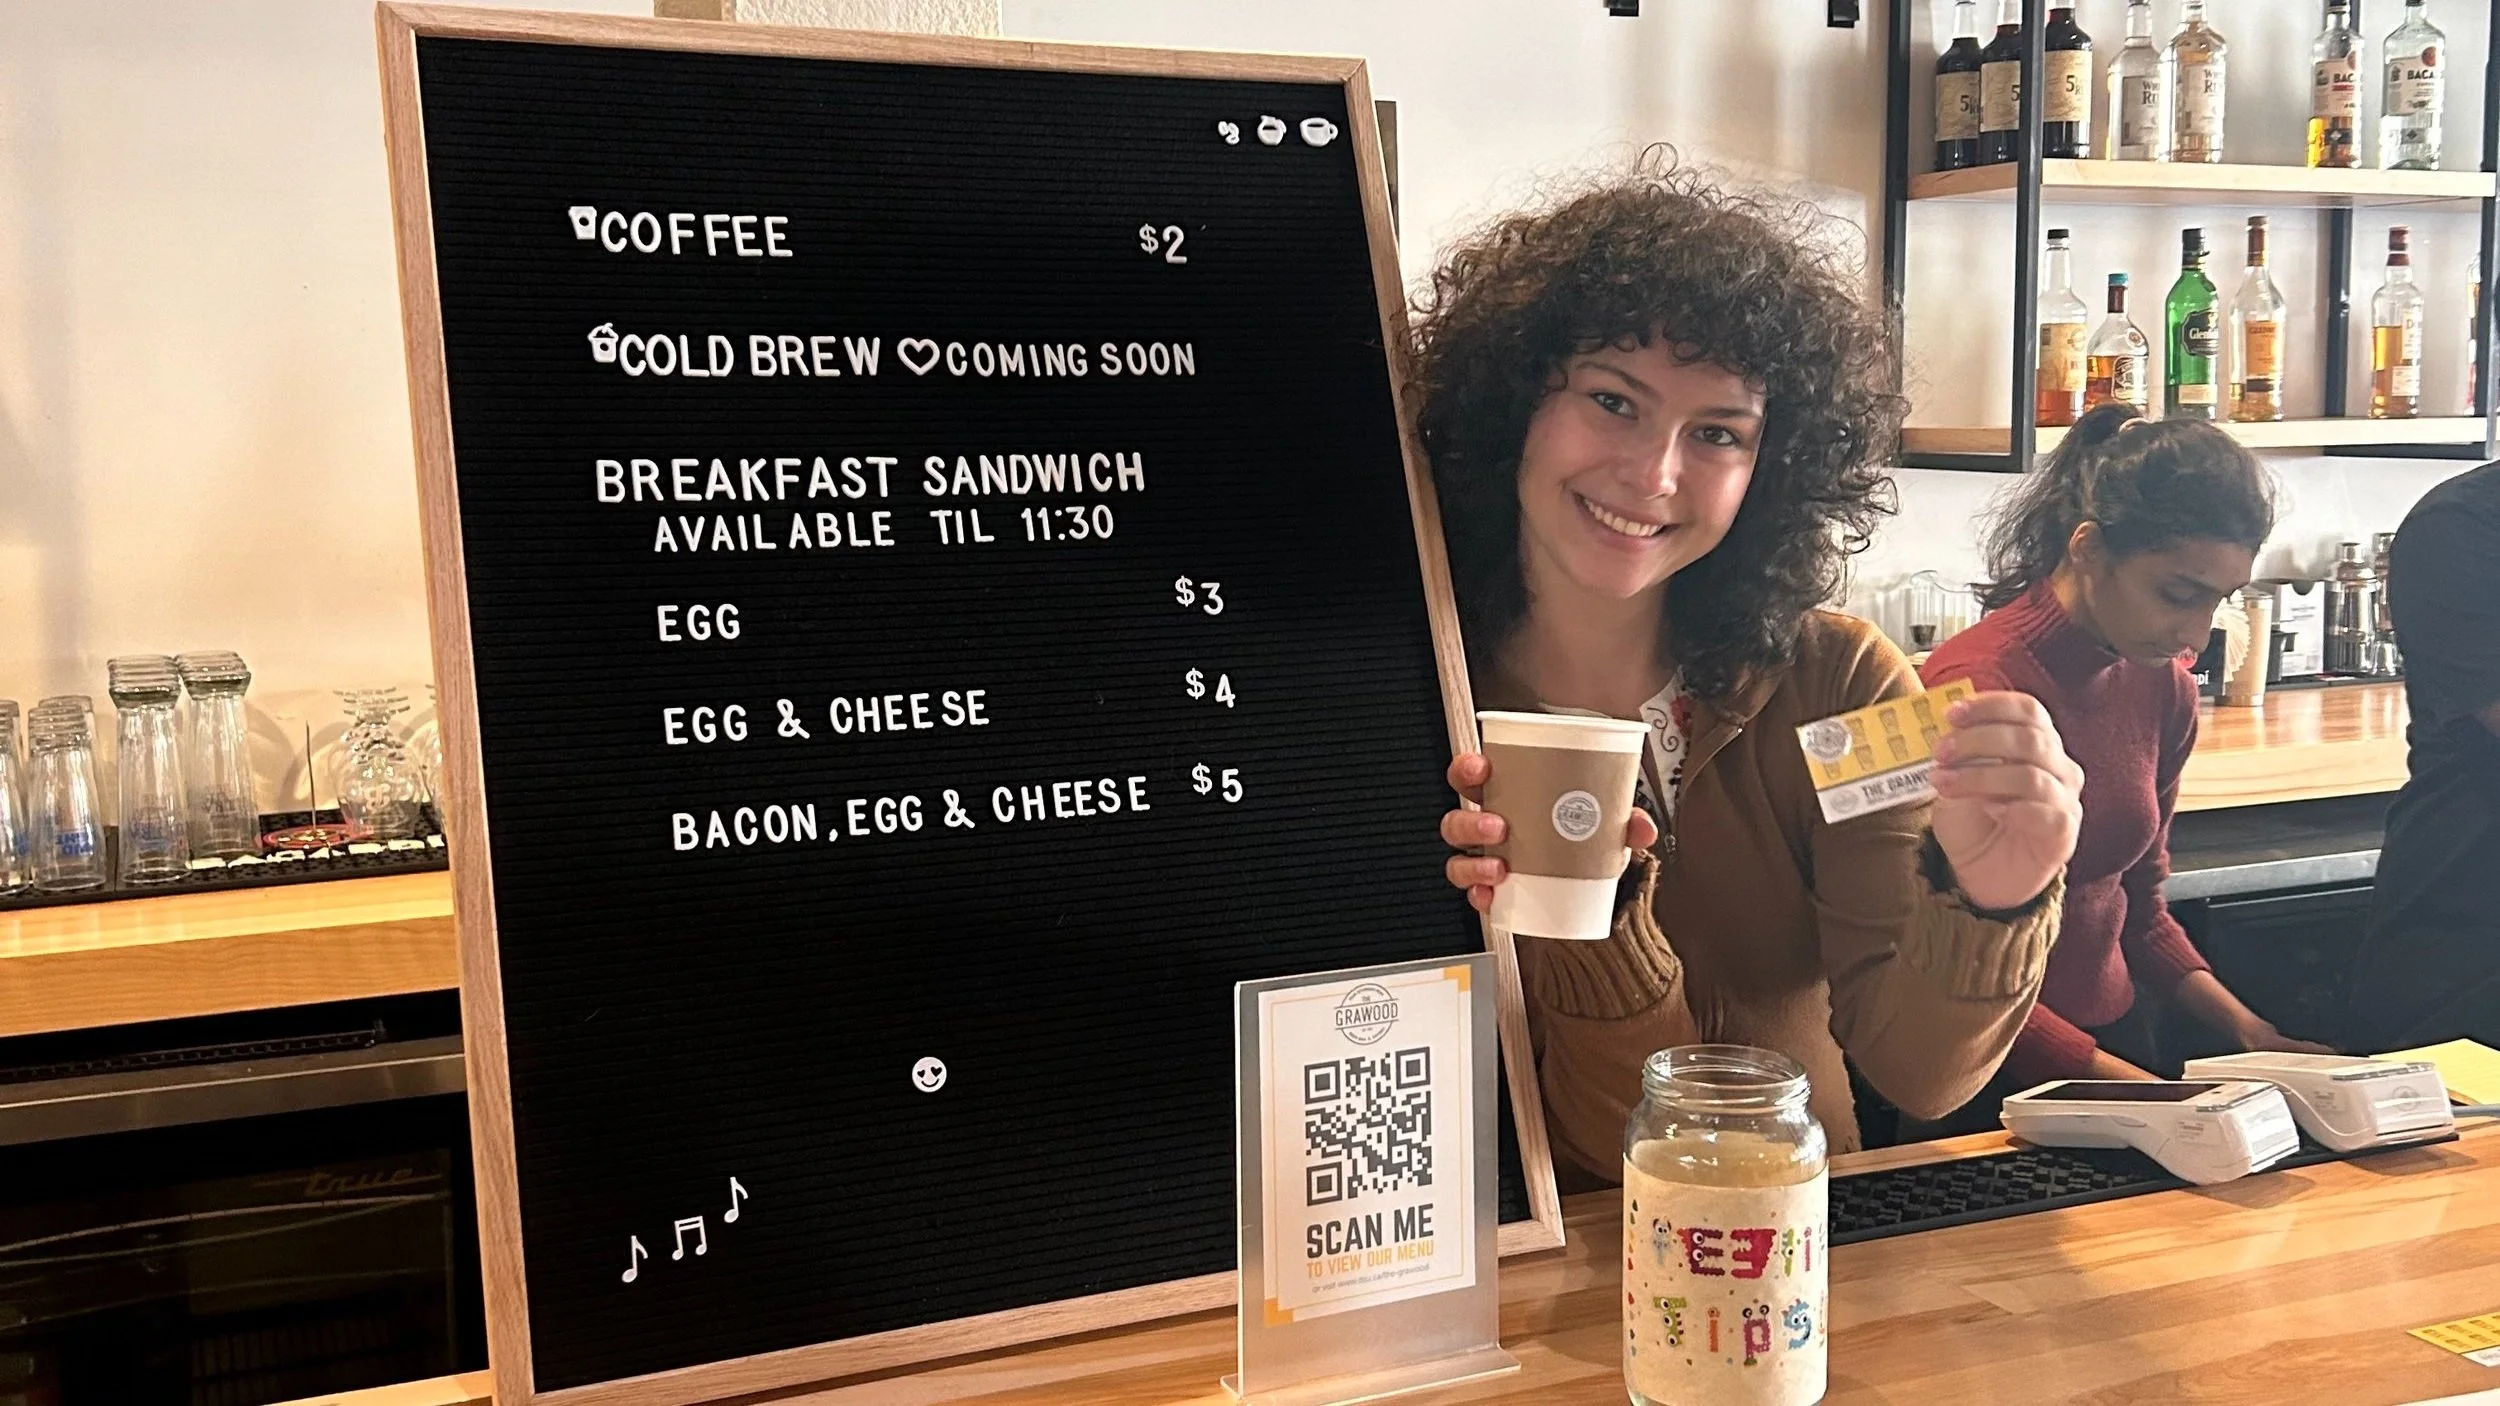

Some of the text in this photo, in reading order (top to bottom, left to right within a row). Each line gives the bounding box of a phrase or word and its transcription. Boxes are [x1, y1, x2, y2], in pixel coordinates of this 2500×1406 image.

[600, 210, 1188, 263] COFFEE $2
[619, 333, 1196, 378] COLD BREW COMING SOON
[596, 451, 1145, 503] BREAKFAST SANDWICH
[654, 504, 1114, 553] AVAILABLE TIL 11:30
[657, 575, 1224, 642] EGG $3
[663, 704, 748, 745] EGG
[776, 698, 811, 740] &
[829, 689, 990, 735] CHEESE
[942, 788, 976, 829] &
[991, 775, 1151, 823] CHEESE
[1335, 1002, 1398, 1026] GRAWOOD
[1306, 1203, 1434, 1259] SCAN ME
[1306, 1239, 1434, 1279] TO VIEW OUR MENU
